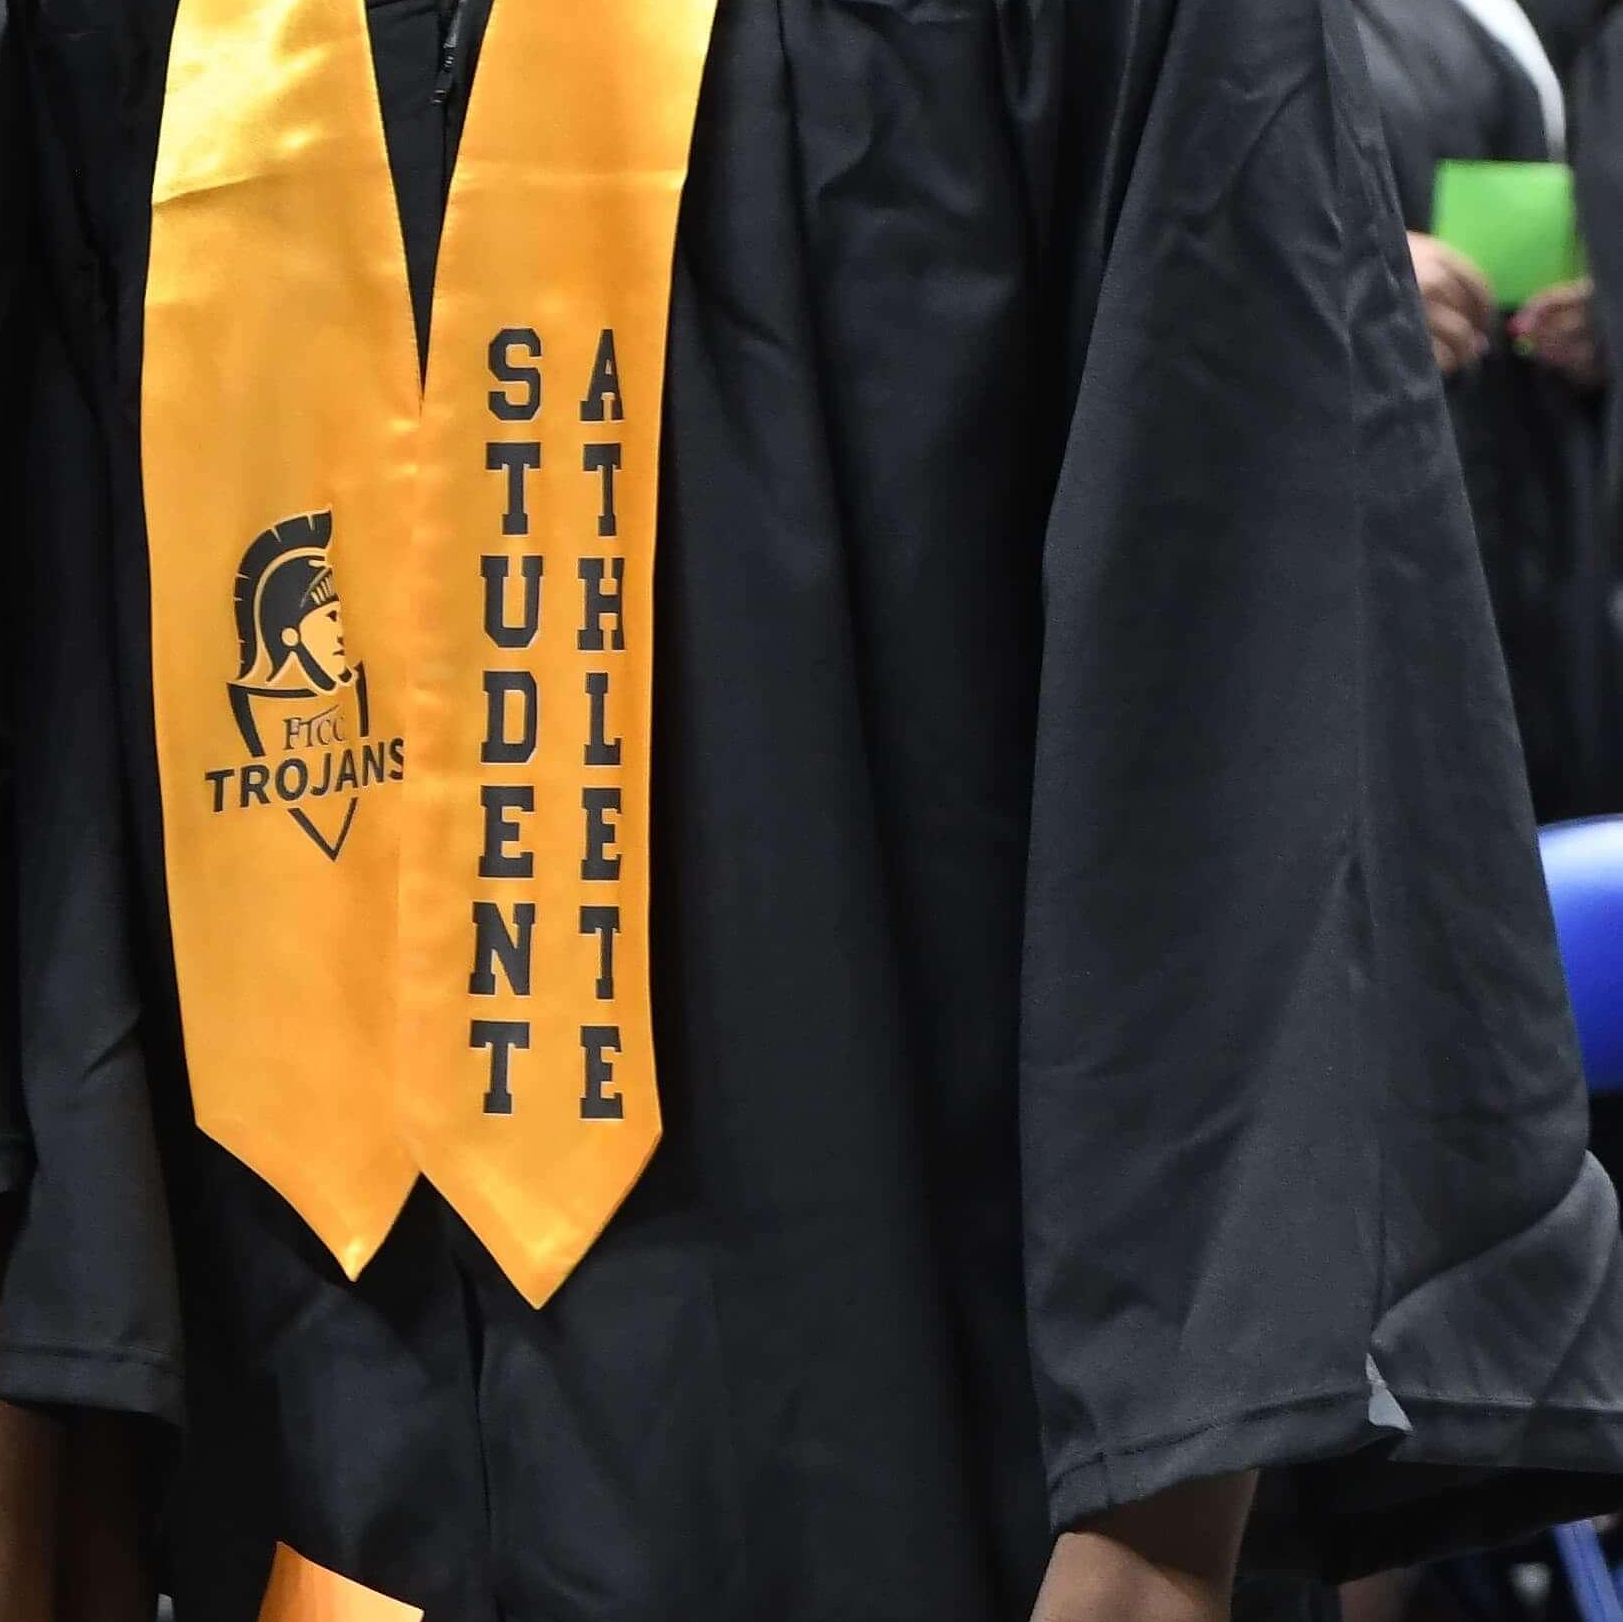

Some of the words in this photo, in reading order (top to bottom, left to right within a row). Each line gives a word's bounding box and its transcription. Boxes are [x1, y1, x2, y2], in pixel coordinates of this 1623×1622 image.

[204, 736, 404, 813] TROJANS
[281, 704, 346, 750] FTCC
[469, 328, 544, 1117] STUDENT
[576, 328, 625, 1119] ATHLETE
